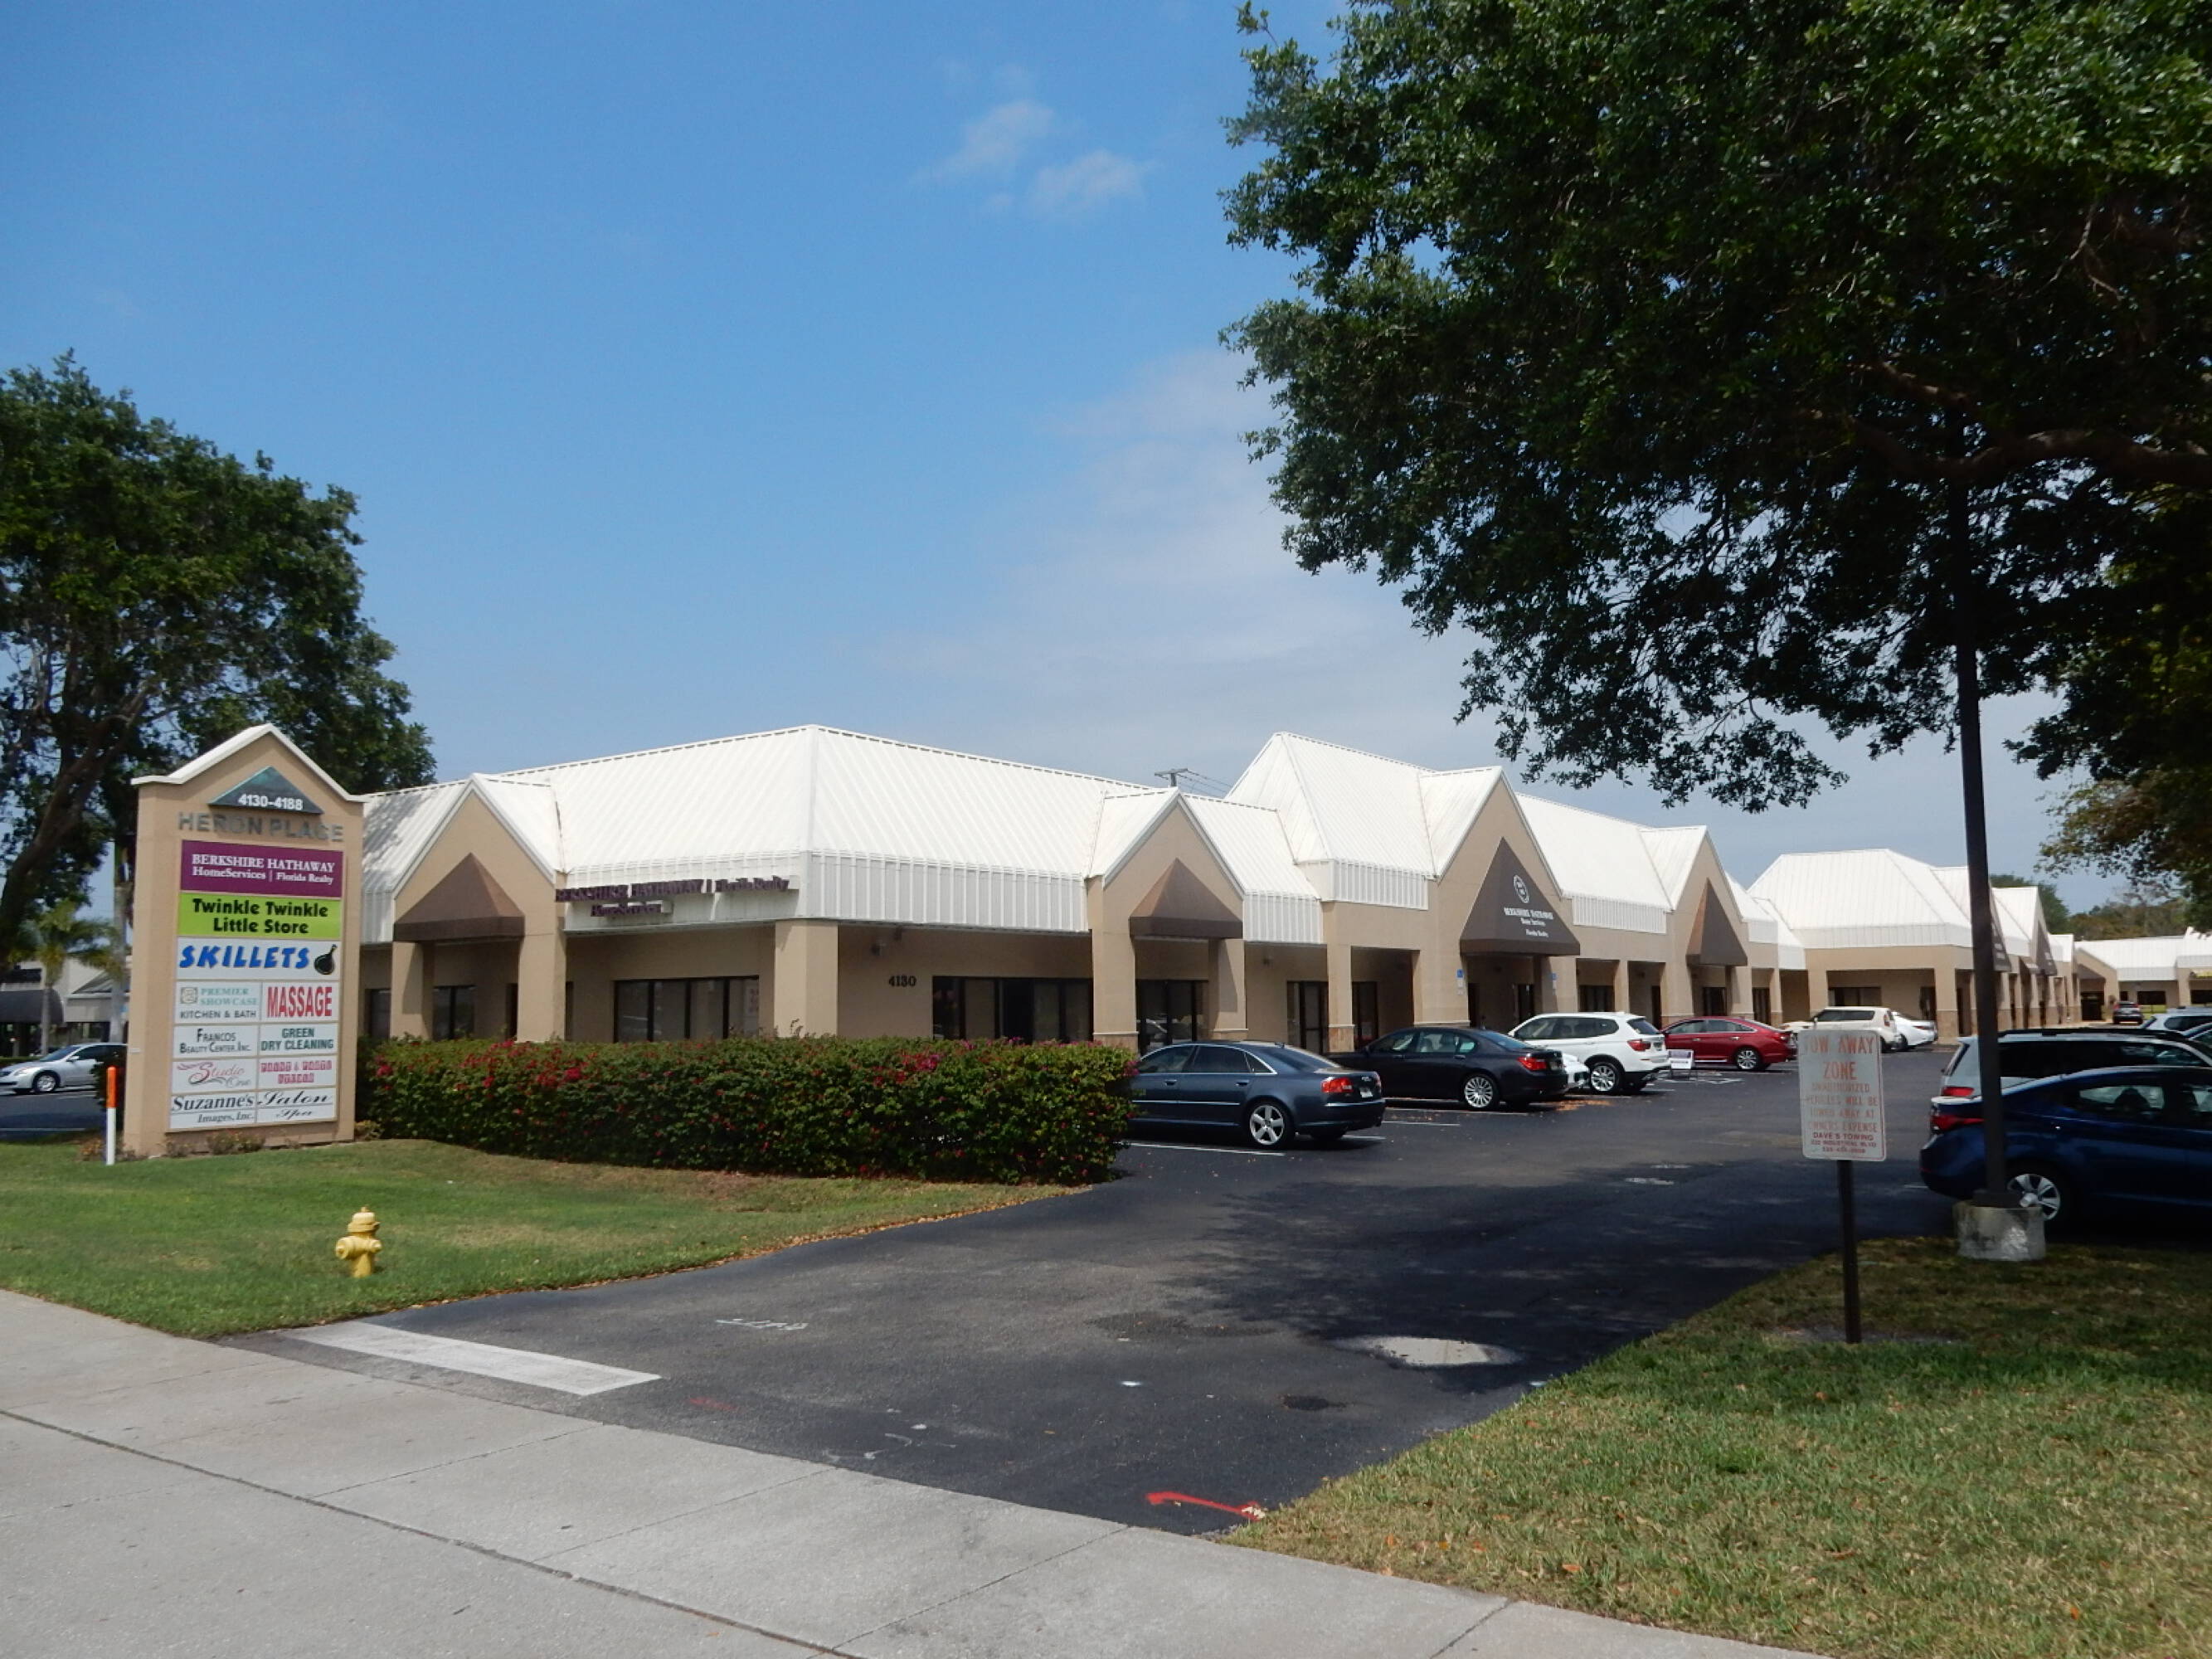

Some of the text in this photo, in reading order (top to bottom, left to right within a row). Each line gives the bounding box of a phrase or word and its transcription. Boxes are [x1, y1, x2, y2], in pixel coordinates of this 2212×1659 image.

[238, 793, 304, 810] 4130-4188
[178, 811, 343, 842] HERON PLACE
[192, 854, 335, 873] BERKSHIRE HATHAWAY
[192, 867, 333, 885] HomeServices Florida Realty
[192, 898, 328, 917] Twinkle Twinkle
[213, 917, 309, 934] Little Store
[179, 945, 309, 969] SKILLETS
[888, 975, 916, 987] 4130
[200, 997, 257, 1006] SHOWCASE
[267, 986, 333, 1018] MASSAGE
[180, 1010, 221, 1019] KITCHEN
[234, 1010, 256, 1019] BATH
[282, 1028, 315, 1038] GREEN
[260, 1039, 334, 1051] DRY CLEANING
[1838, 1035, 1874, 1054] AWAY
[188, 1061, 246, 1085] Studio
[1823, 1062, 1857, 1080] ZONE
[172, 1091, 331, 1111] Suzanne's Salon
